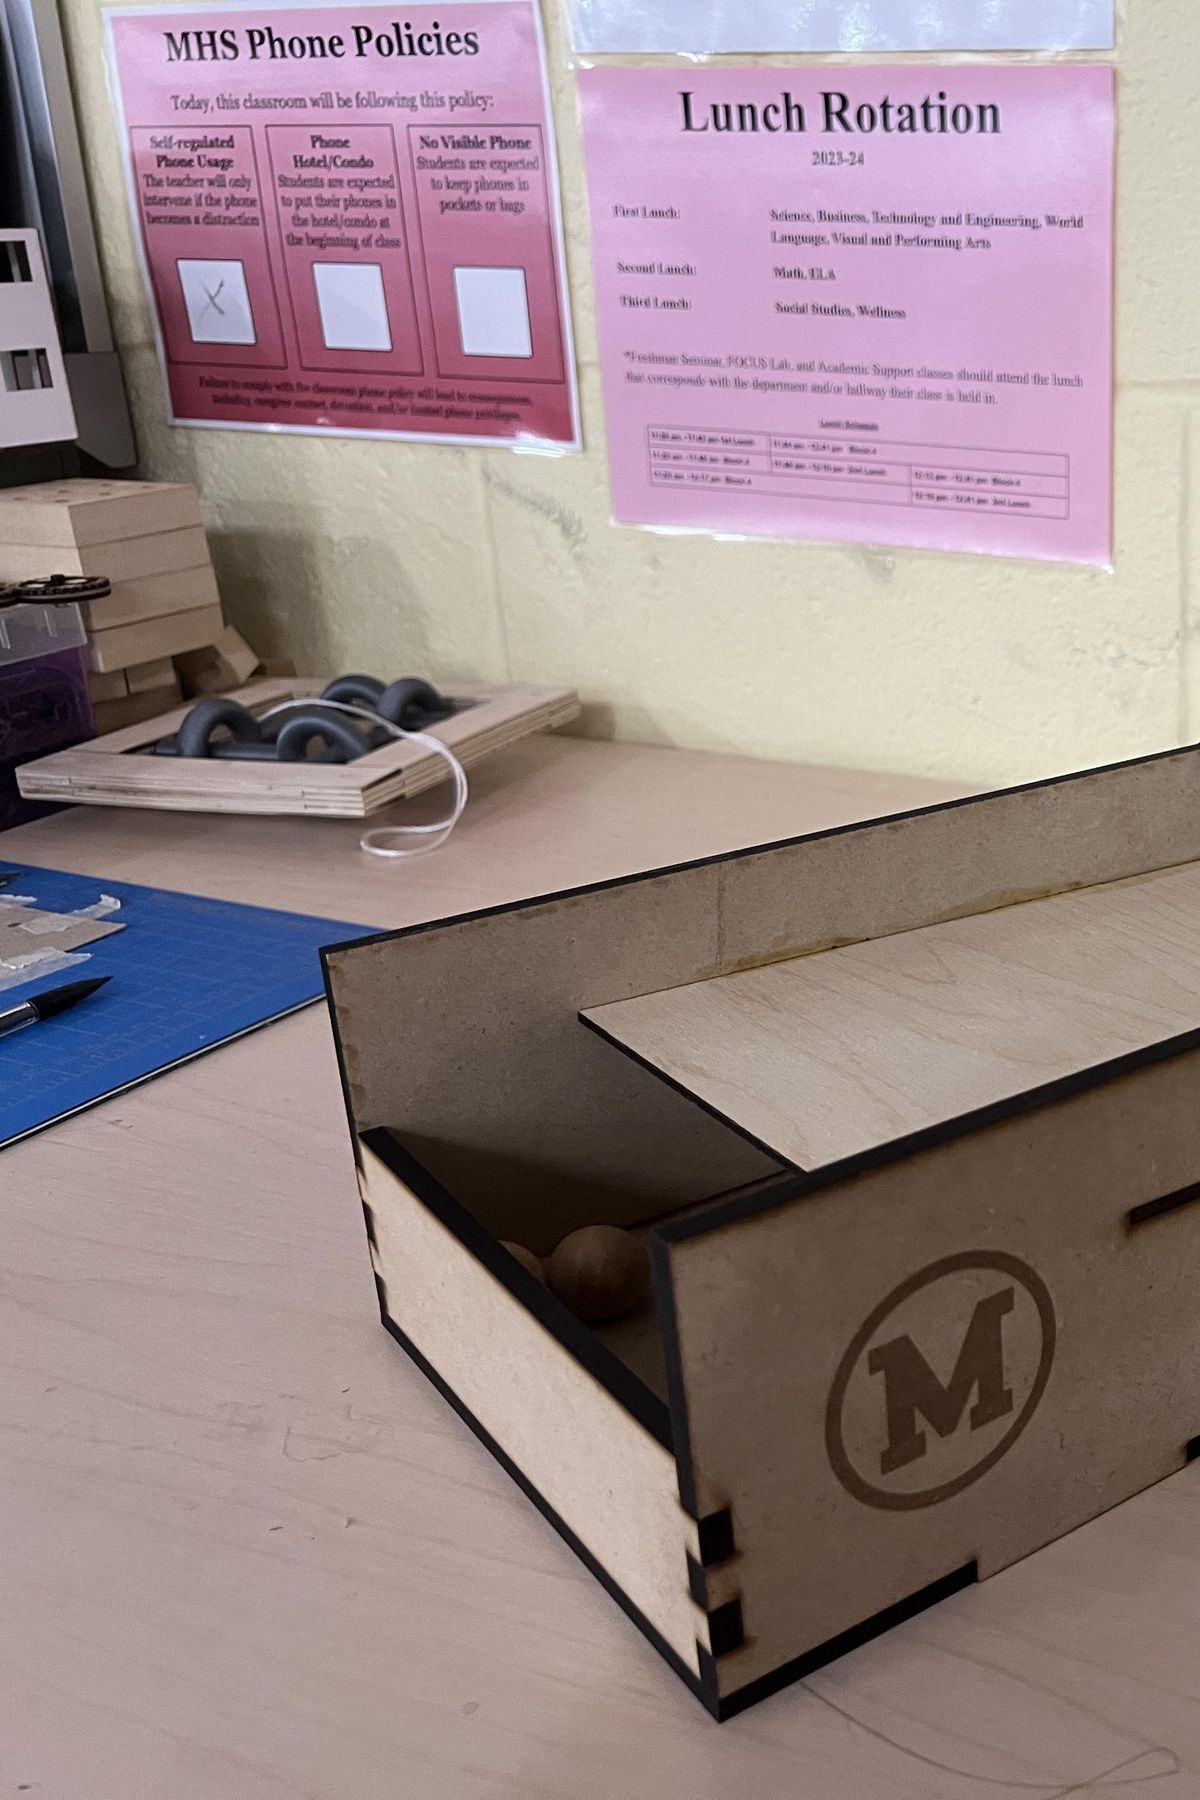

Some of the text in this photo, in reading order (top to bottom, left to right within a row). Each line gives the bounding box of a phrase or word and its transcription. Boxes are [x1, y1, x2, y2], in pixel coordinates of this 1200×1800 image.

[163, 21, 479, 61] MHS Phone Policies
[170, 91, 494, 113] Today, this classroom will be following this policy:
[678, 91, 1001, 133] Lunch Rotation
[150, 135, 235, 152] Self-regulated
[310, 134, 351, 149] Phone
[420, 134, 532, 150] No Visible Phone
[156, 154, 234, 171] Phone Usage
[293, 154, 374, 171] Hotel/Condo
[416, 154, 539, 174] Students are expected
[812, 151, 865, 166] 2023-24
[143, 174, 163, 187] The
[166, 174, 204, 188] teacher
[206, 174, 226, 188] will
[278, 173, 395, 192] Students are expected
[430, 175, 529, 194] to keep phones in
[205, 193, 222, 206] the
[225, 193, 257, 211] phone
[281, 193, 397, 211] to put their phones in
[440, 197, 525, 215] pockets or bags
[146, 211, 259, 226] becomes a distraction
[291, 213, 390, 229] the hotel/condo at
[613, 205, 680, 219] First Lunch:
[769, 209, 1084, 229] Science, Business, Technology and Engineering, World
[286, 231, 401, 251] the beginning of class
[770, 230, 991, 250] Language, Visual and Performing Arts
[617, 261, 697, 276] Second Lunch:
[809, 267, 836, 280] ELA
[620, 295, 692, 310] Third Lunch:
[775, 302, 907, 319] Social Studies, Wellness
[728, 354, 768, 370] FOCUS
[797, 360, 815, 372] and
[818, 360, 869, 375] Academic
[872, 363, 913, 379] Support
[916, 366, 954, 380] classes
[957, 368, 993, 382] should
[996, 371, 1029, 385] attend
[1032, 372, 1049, 385] the
[1053, 374, 1083, 388] lunch
[626, 371, 645, 383] that
[647, 372, 706, 388] corresponds
[709, 375, 731, 389] with
[734, 375, 750, 389] the
[752, 377, 807, 394] department
[811, 381, 843, 395] and/or
[846, 383, 887, 400] hallway
[890, 386, 913, 399] their
[916, 387, 943, 400] class
[958, 390, 981, 403] held
[868, 1286, 1015, 1475] M
